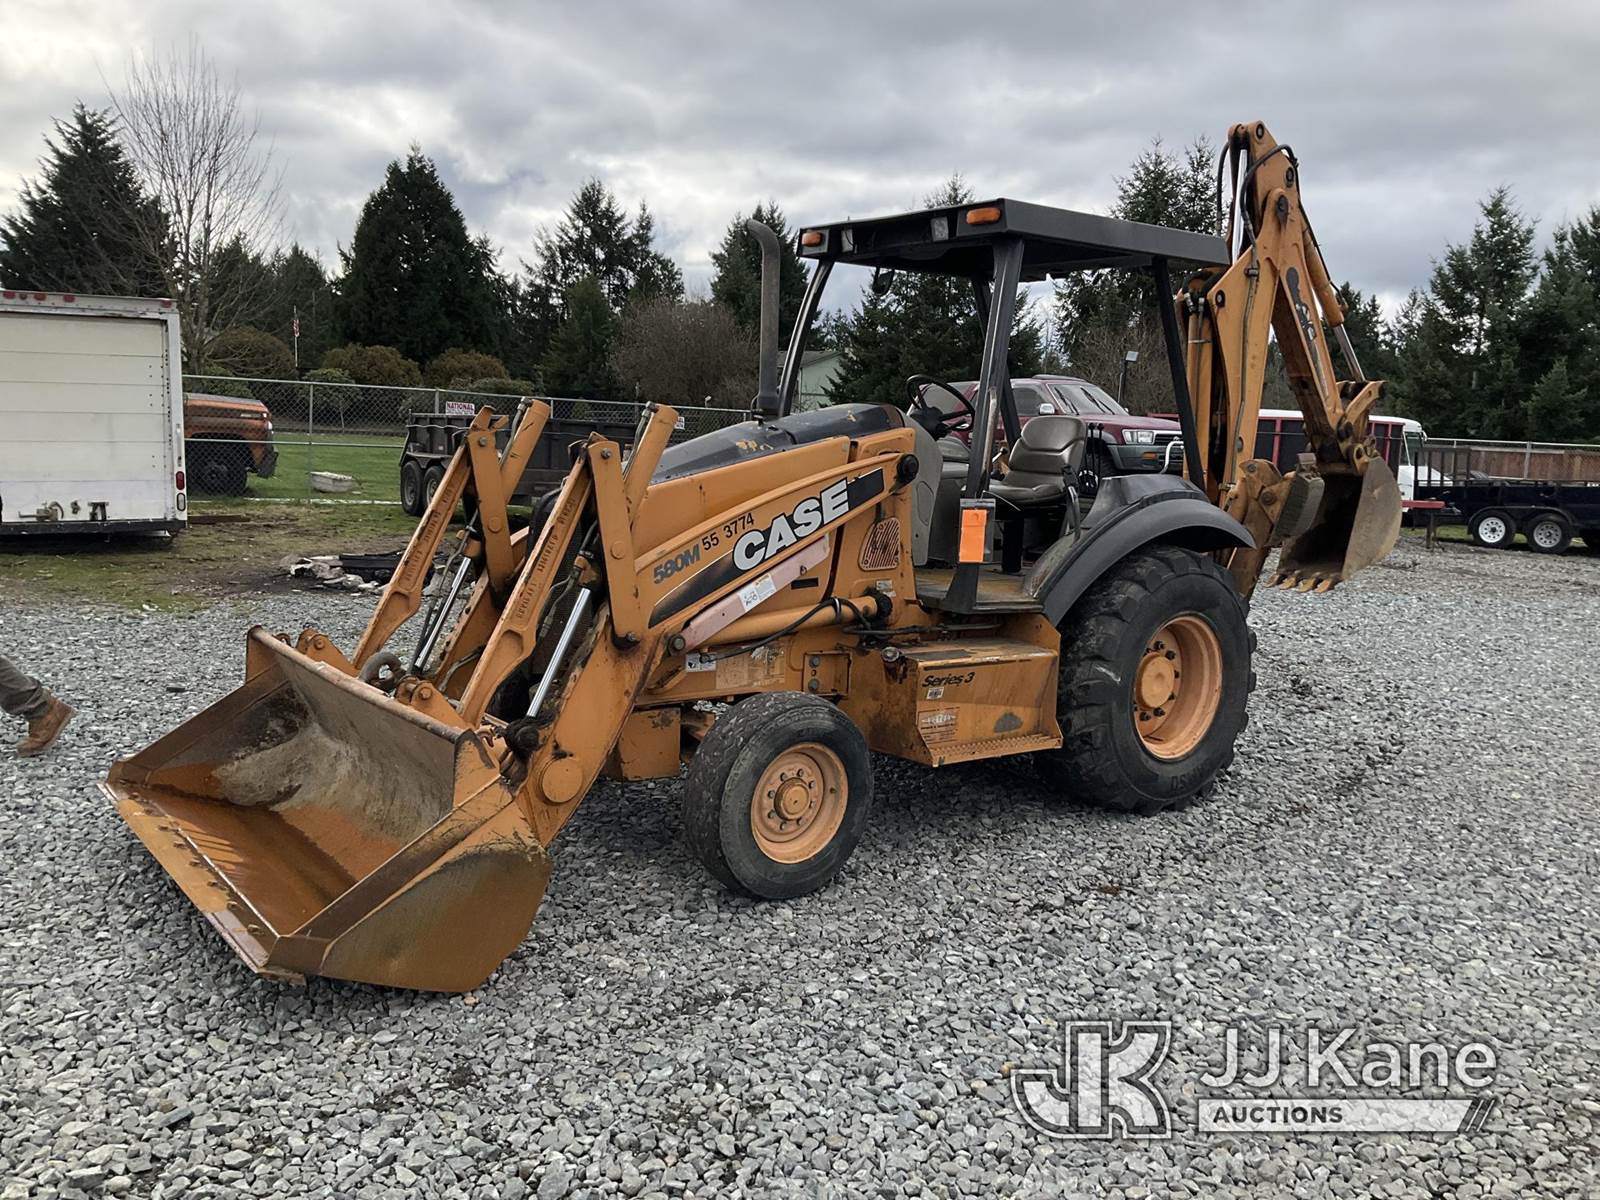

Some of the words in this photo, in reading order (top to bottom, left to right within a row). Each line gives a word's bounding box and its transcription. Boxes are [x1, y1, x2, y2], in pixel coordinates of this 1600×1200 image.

[447, 402, 474, 410] NATIONAL
[701, 532, 720, 551] 55
[723, 512, 755, 539] 3774
[731, 477, 850, 572] CASE
[653, 543, 701, 584] 580M
[922, 673, 964, 687] Series
[964, 671, 975, 683] 3
